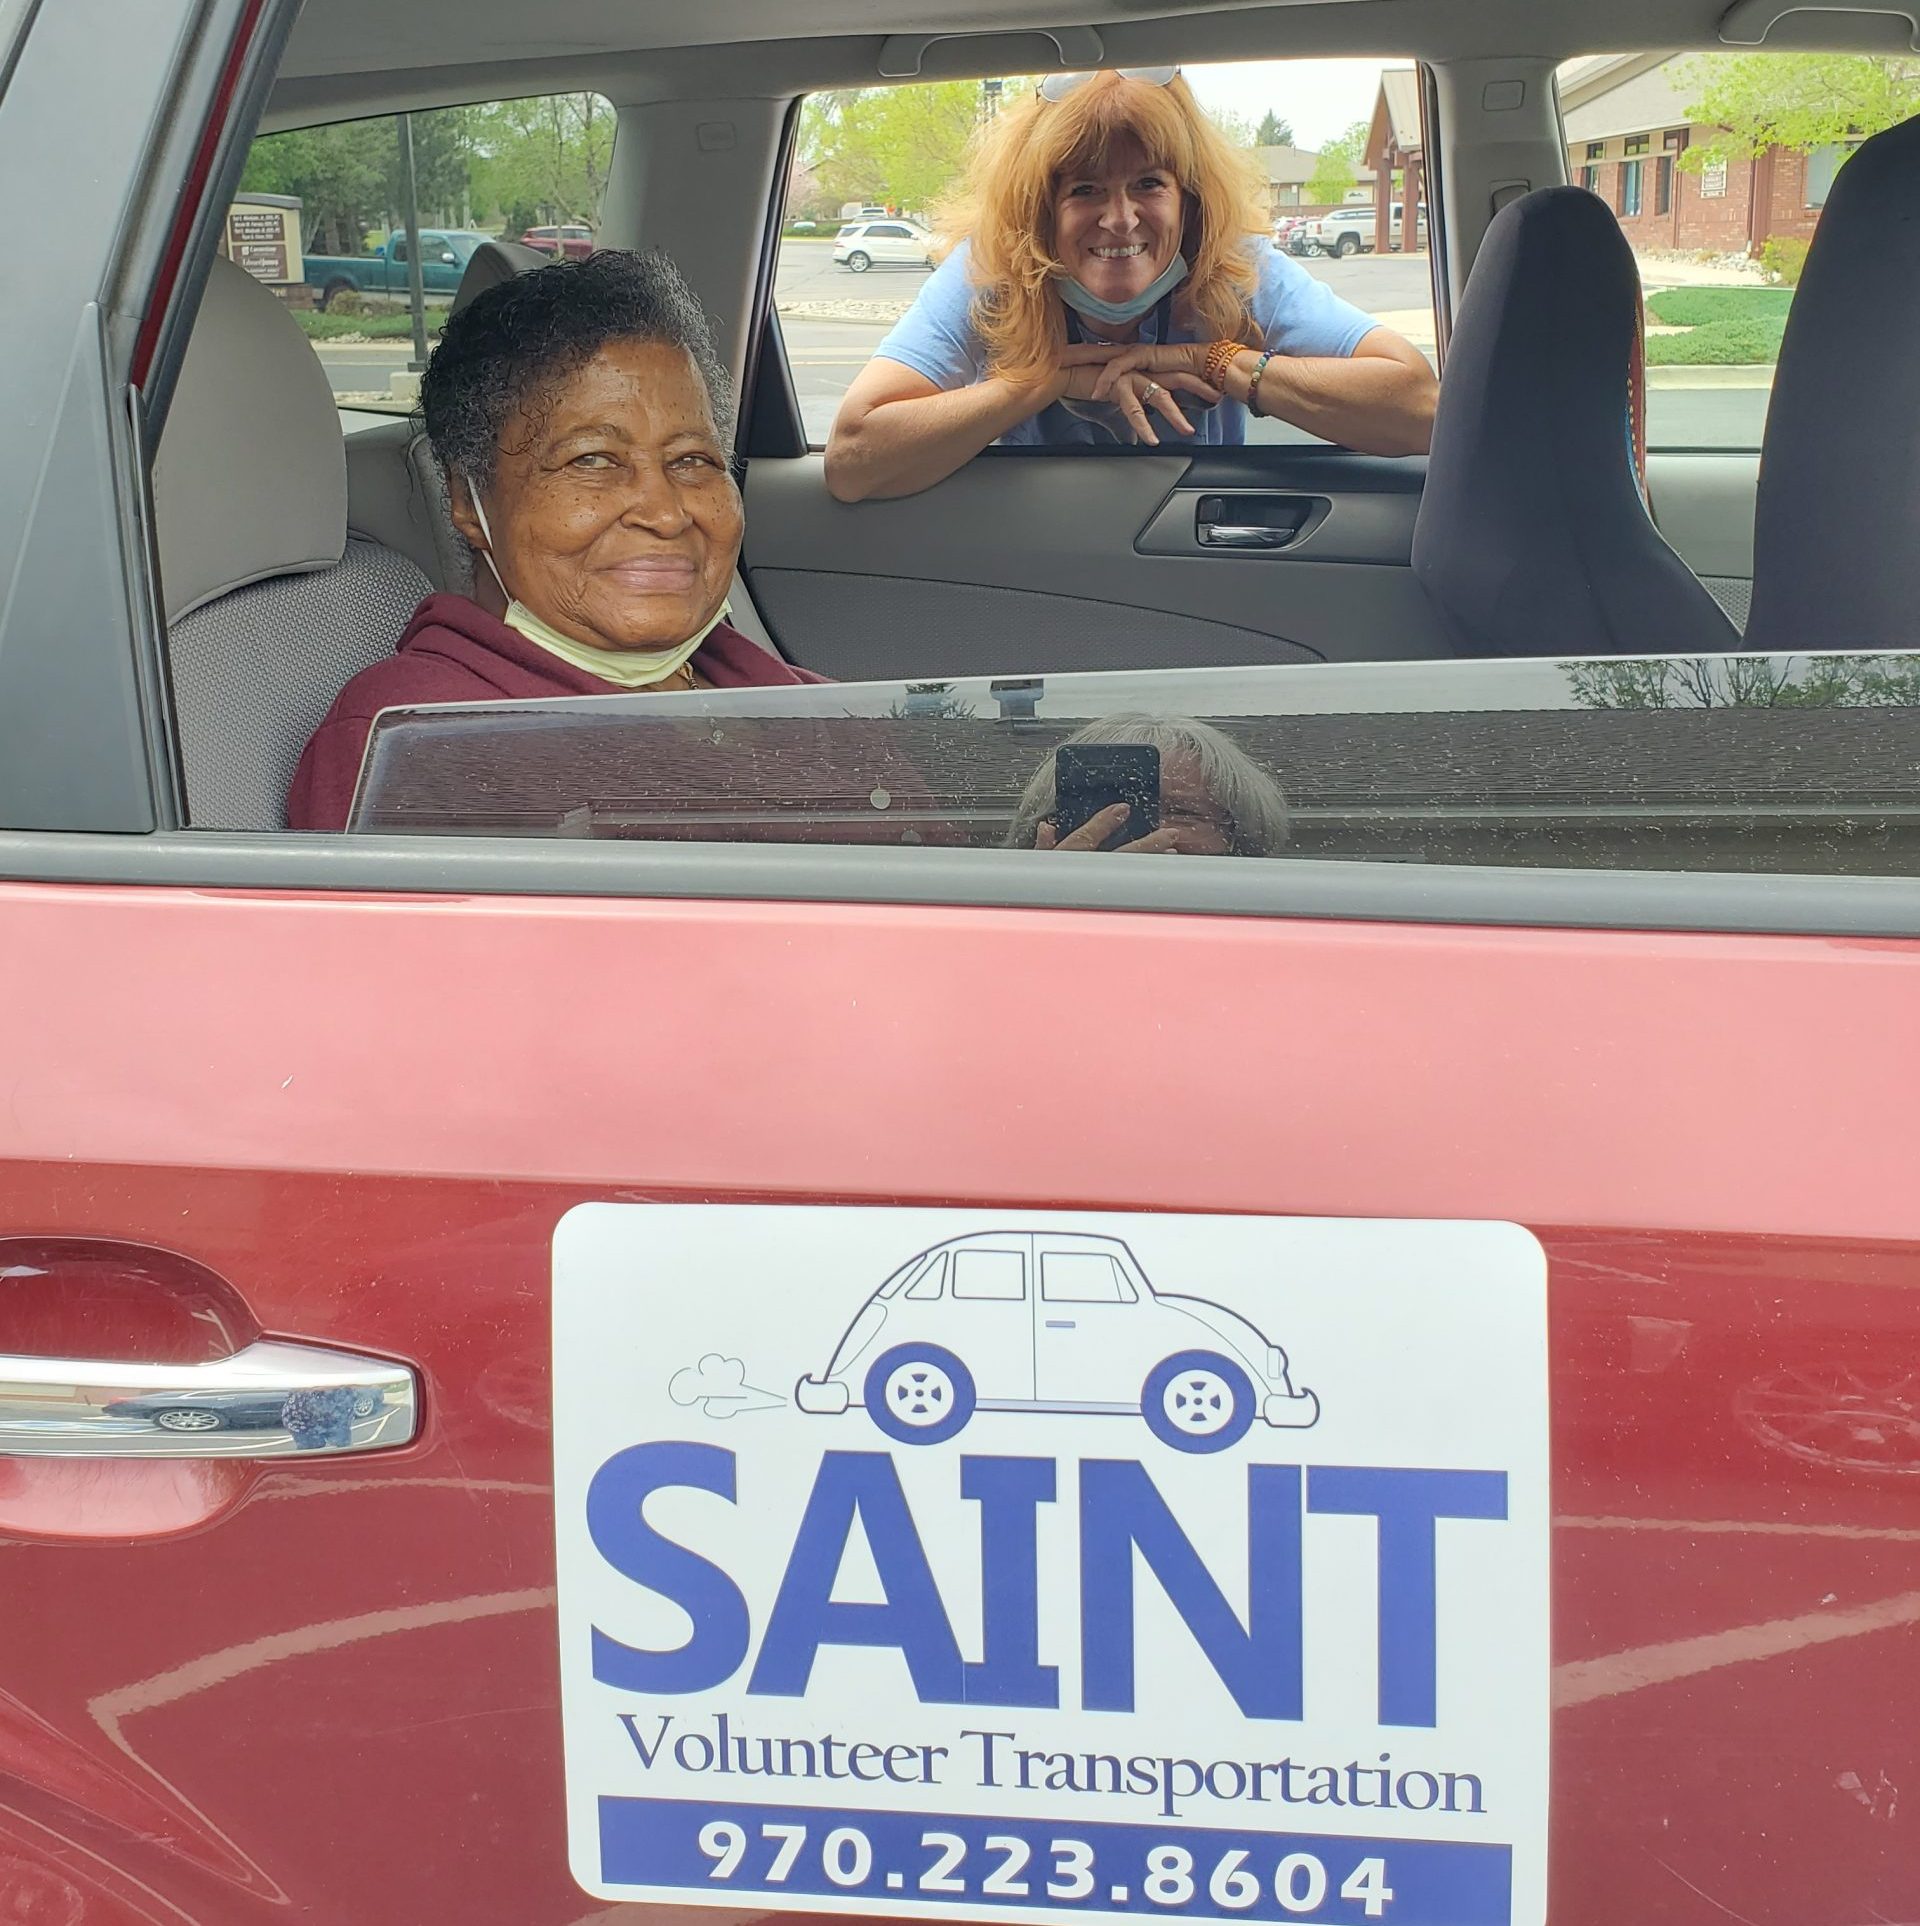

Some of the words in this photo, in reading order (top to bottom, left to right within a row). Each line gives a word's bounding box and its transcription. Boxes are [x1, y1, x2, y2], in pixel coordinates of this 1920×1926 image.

[585, 1440, 1509, 1728] SAINT
[616, 1713, 949, 1786] Volunteer
[960, 1729, 1488, 1818] Transportation
[697, 1819, 1394, 1917] 970.223.8604
